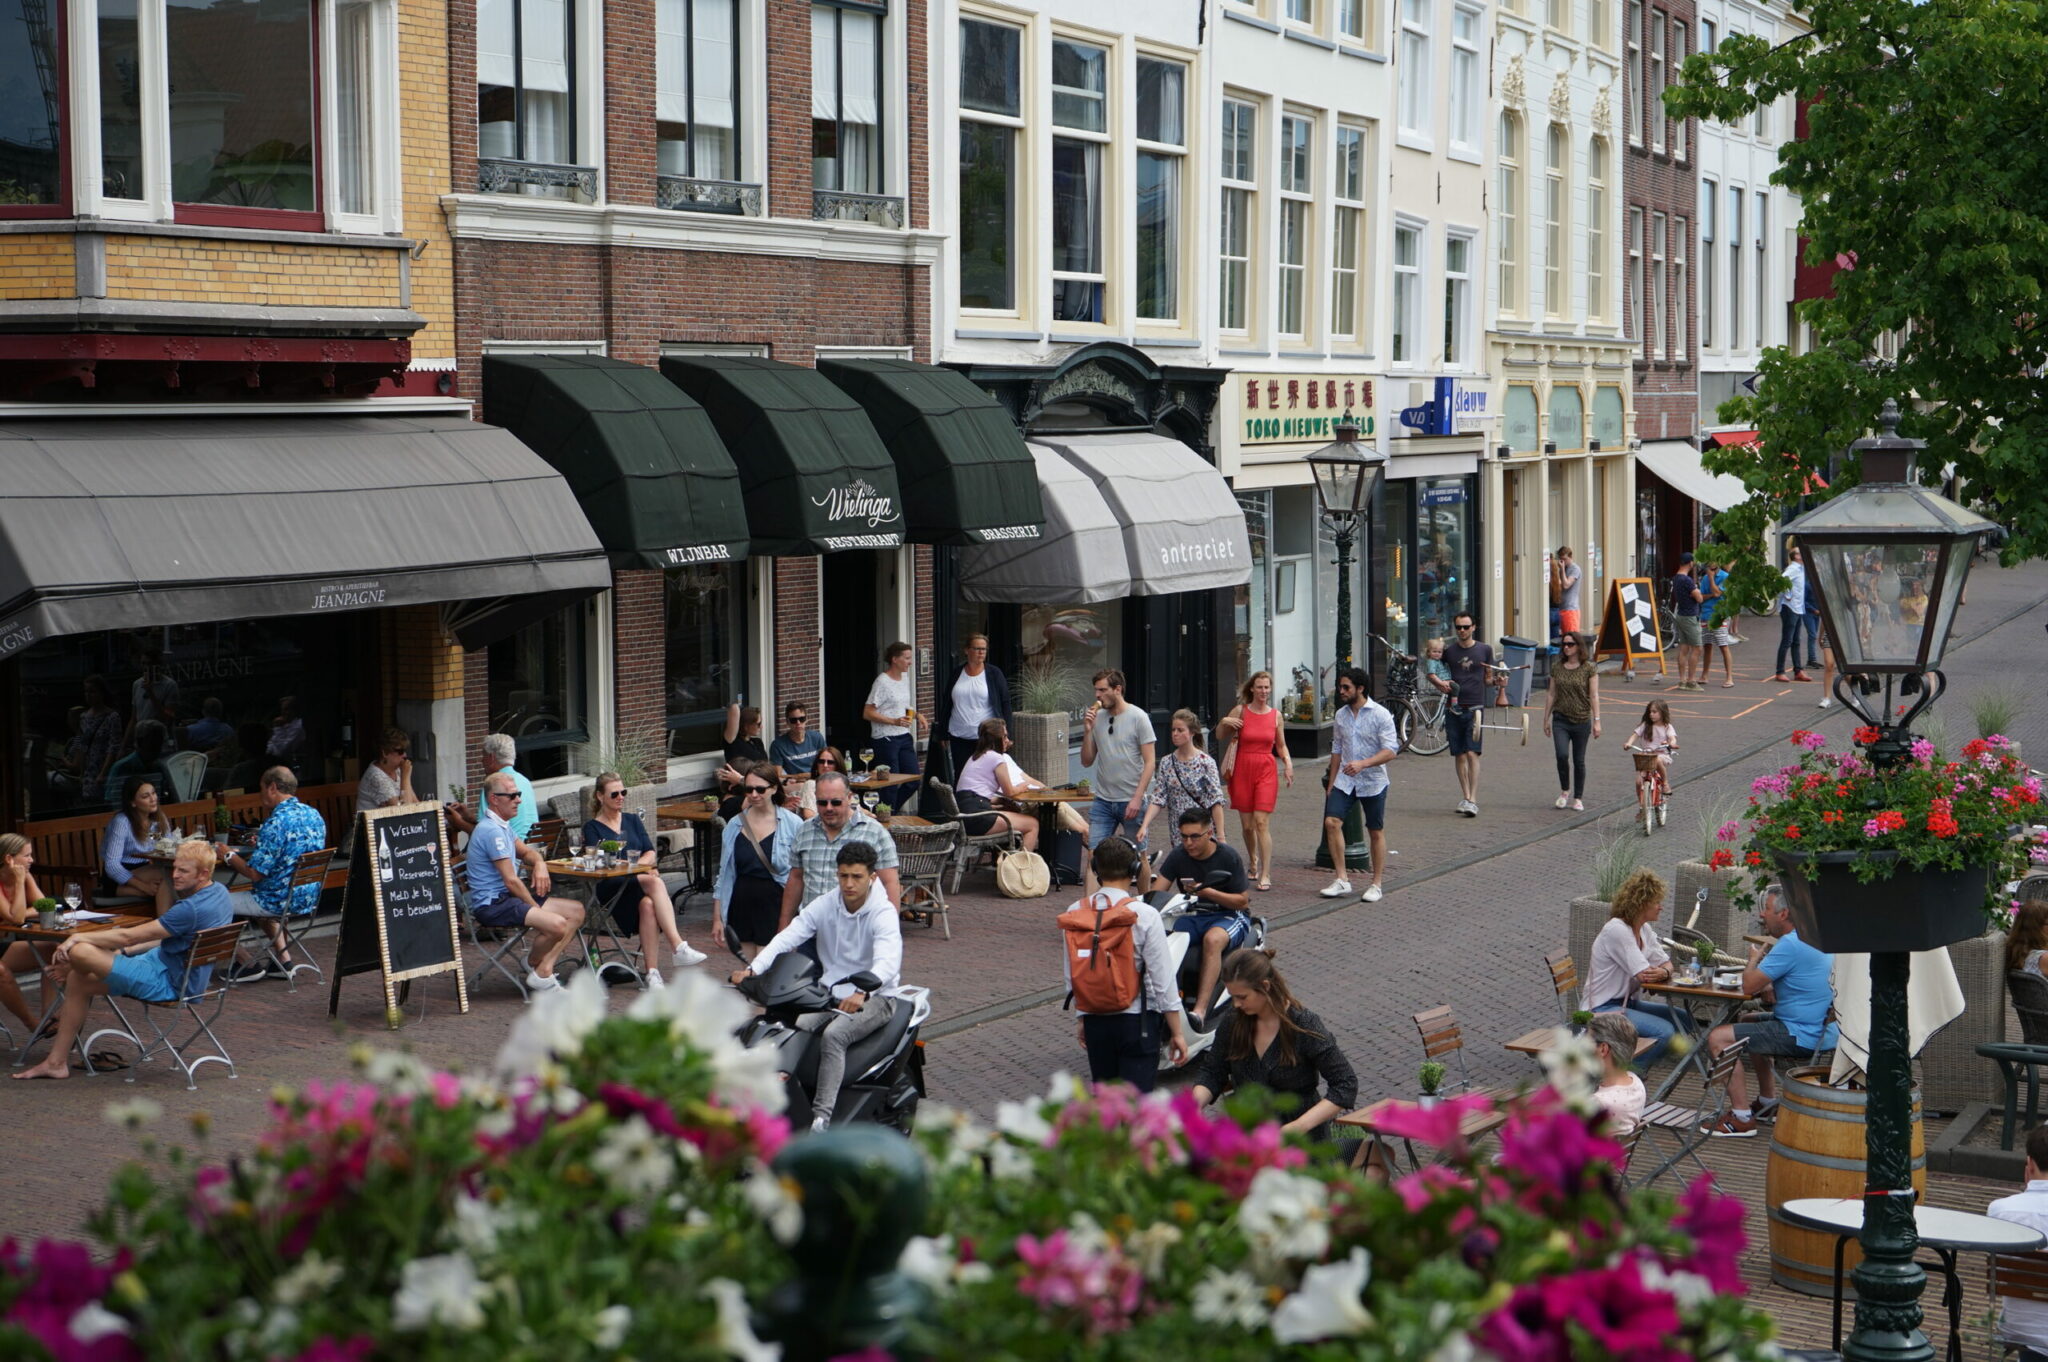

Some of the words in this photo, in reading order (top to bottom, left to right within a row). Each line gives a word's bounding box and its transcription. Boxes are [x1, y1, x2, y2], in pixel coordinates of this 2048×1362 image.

[1246, 418, 1280, 440] TOKO
[1284, 417, 1329, 437] NIEUWE
[812, 487, 900, 528] Wielinga
[824, 533, 900, 549] RESTAURANT
[980, 525, 1040, 540] BRASSERIE
[666, 544, 731, 564] WIJNBAR
[1161, 537, 1234, 564] antraciet
[312, 590, 385, 609] JEANPAGNE
